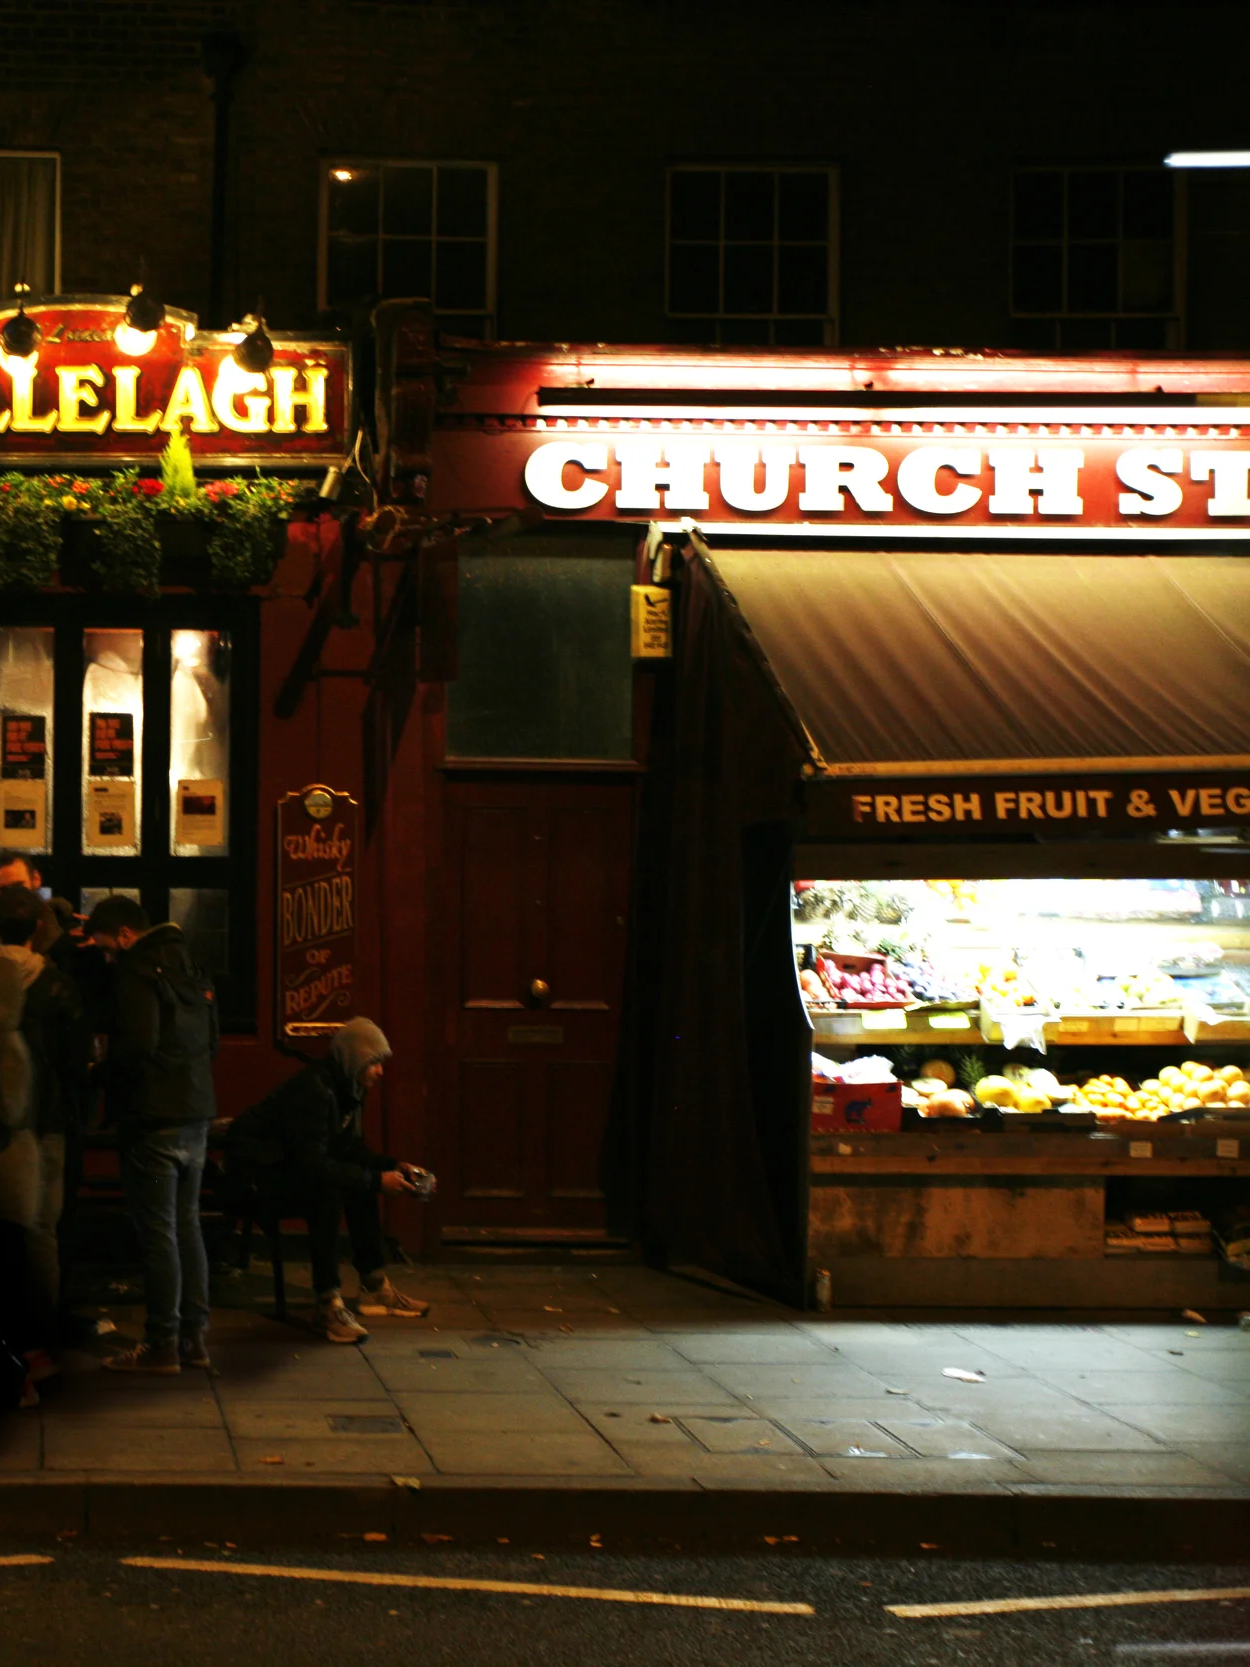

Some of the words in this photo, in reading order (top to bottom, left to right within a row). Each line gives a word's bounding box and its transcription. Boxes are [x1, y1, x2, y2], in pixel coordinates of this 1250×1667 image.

[524, 441, 1085, 516] CHURCH
[852, 793, 984, 824] FRESH
[995, 789, 1113, 822] FRUIT
[1125, 788, 1158, 819] &
[283, 822, 352, 872] Whisky
[282, 875, 354, 947] BONDER
[305, 949, 332, 965] OF
[285, 964, 352, 1016] REPUTE
